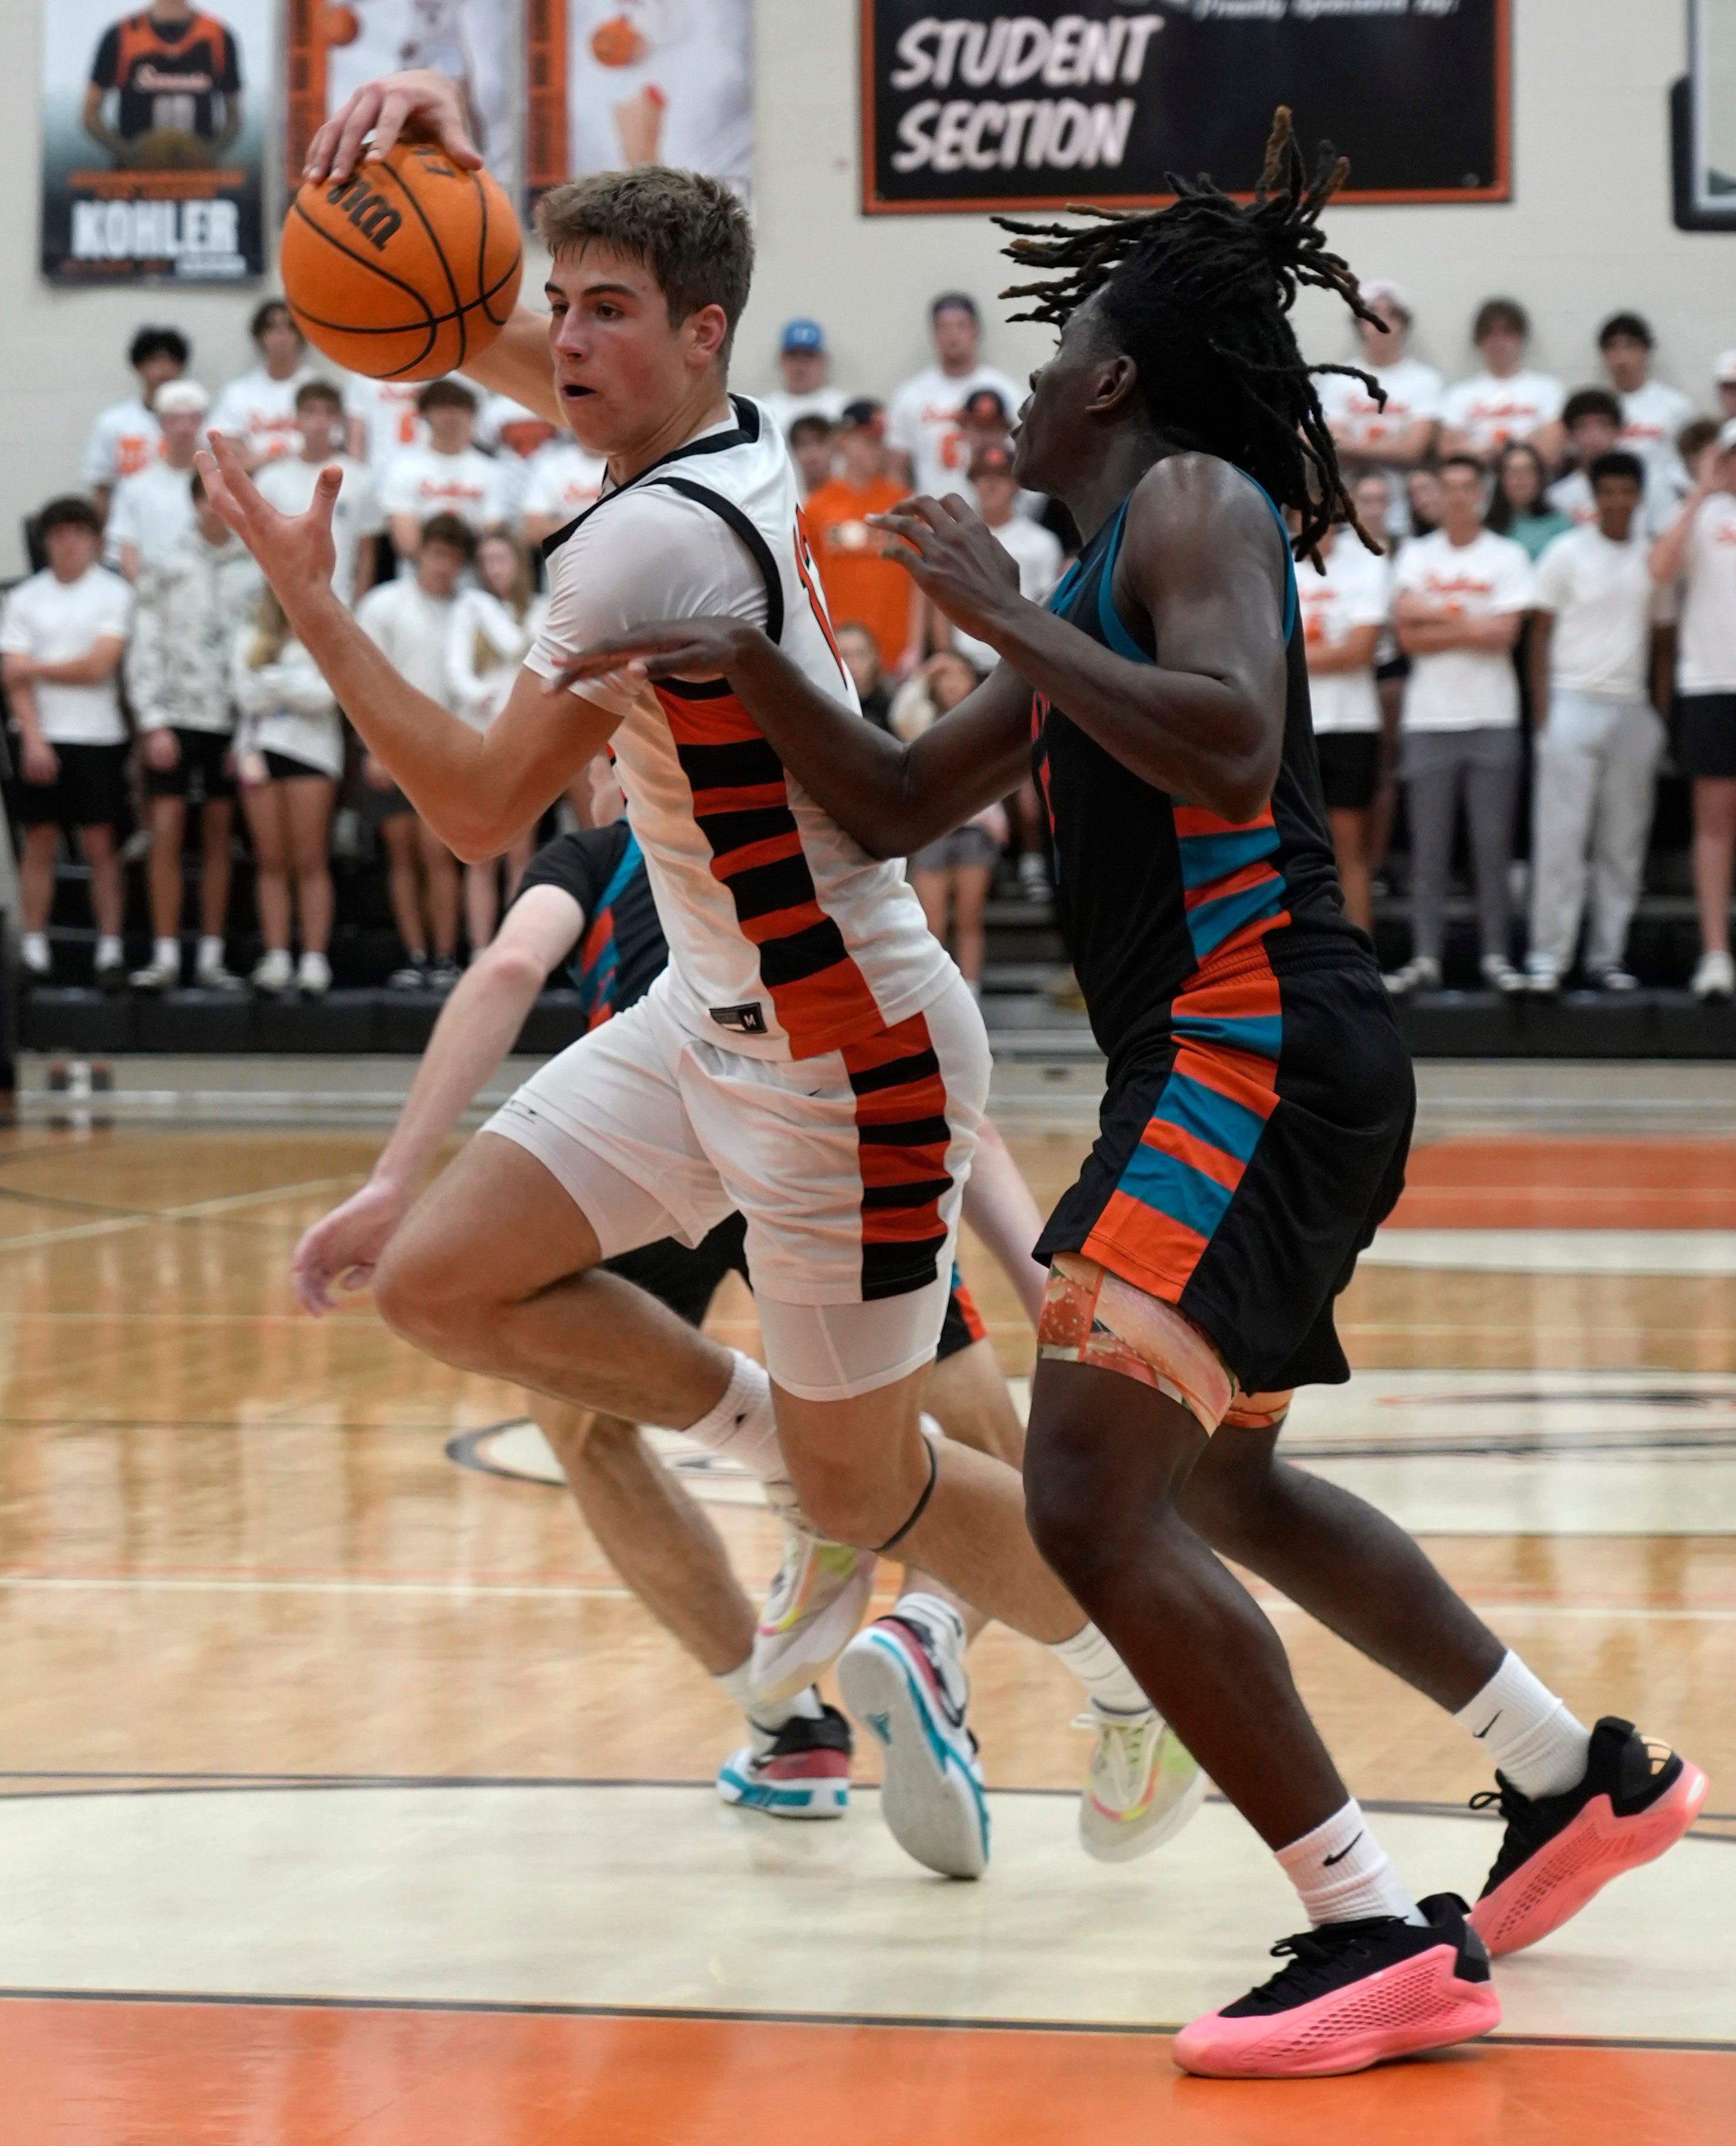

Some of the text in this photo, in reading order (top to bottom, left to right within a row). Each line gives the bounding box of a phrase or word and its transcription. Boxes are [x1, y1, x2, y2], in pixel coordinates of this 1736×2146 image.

[891, 15, 1165, 89] STUDENT
[891, 98, 1135, 171] SECTION
[71, 200, 238, 260] KOHLER
